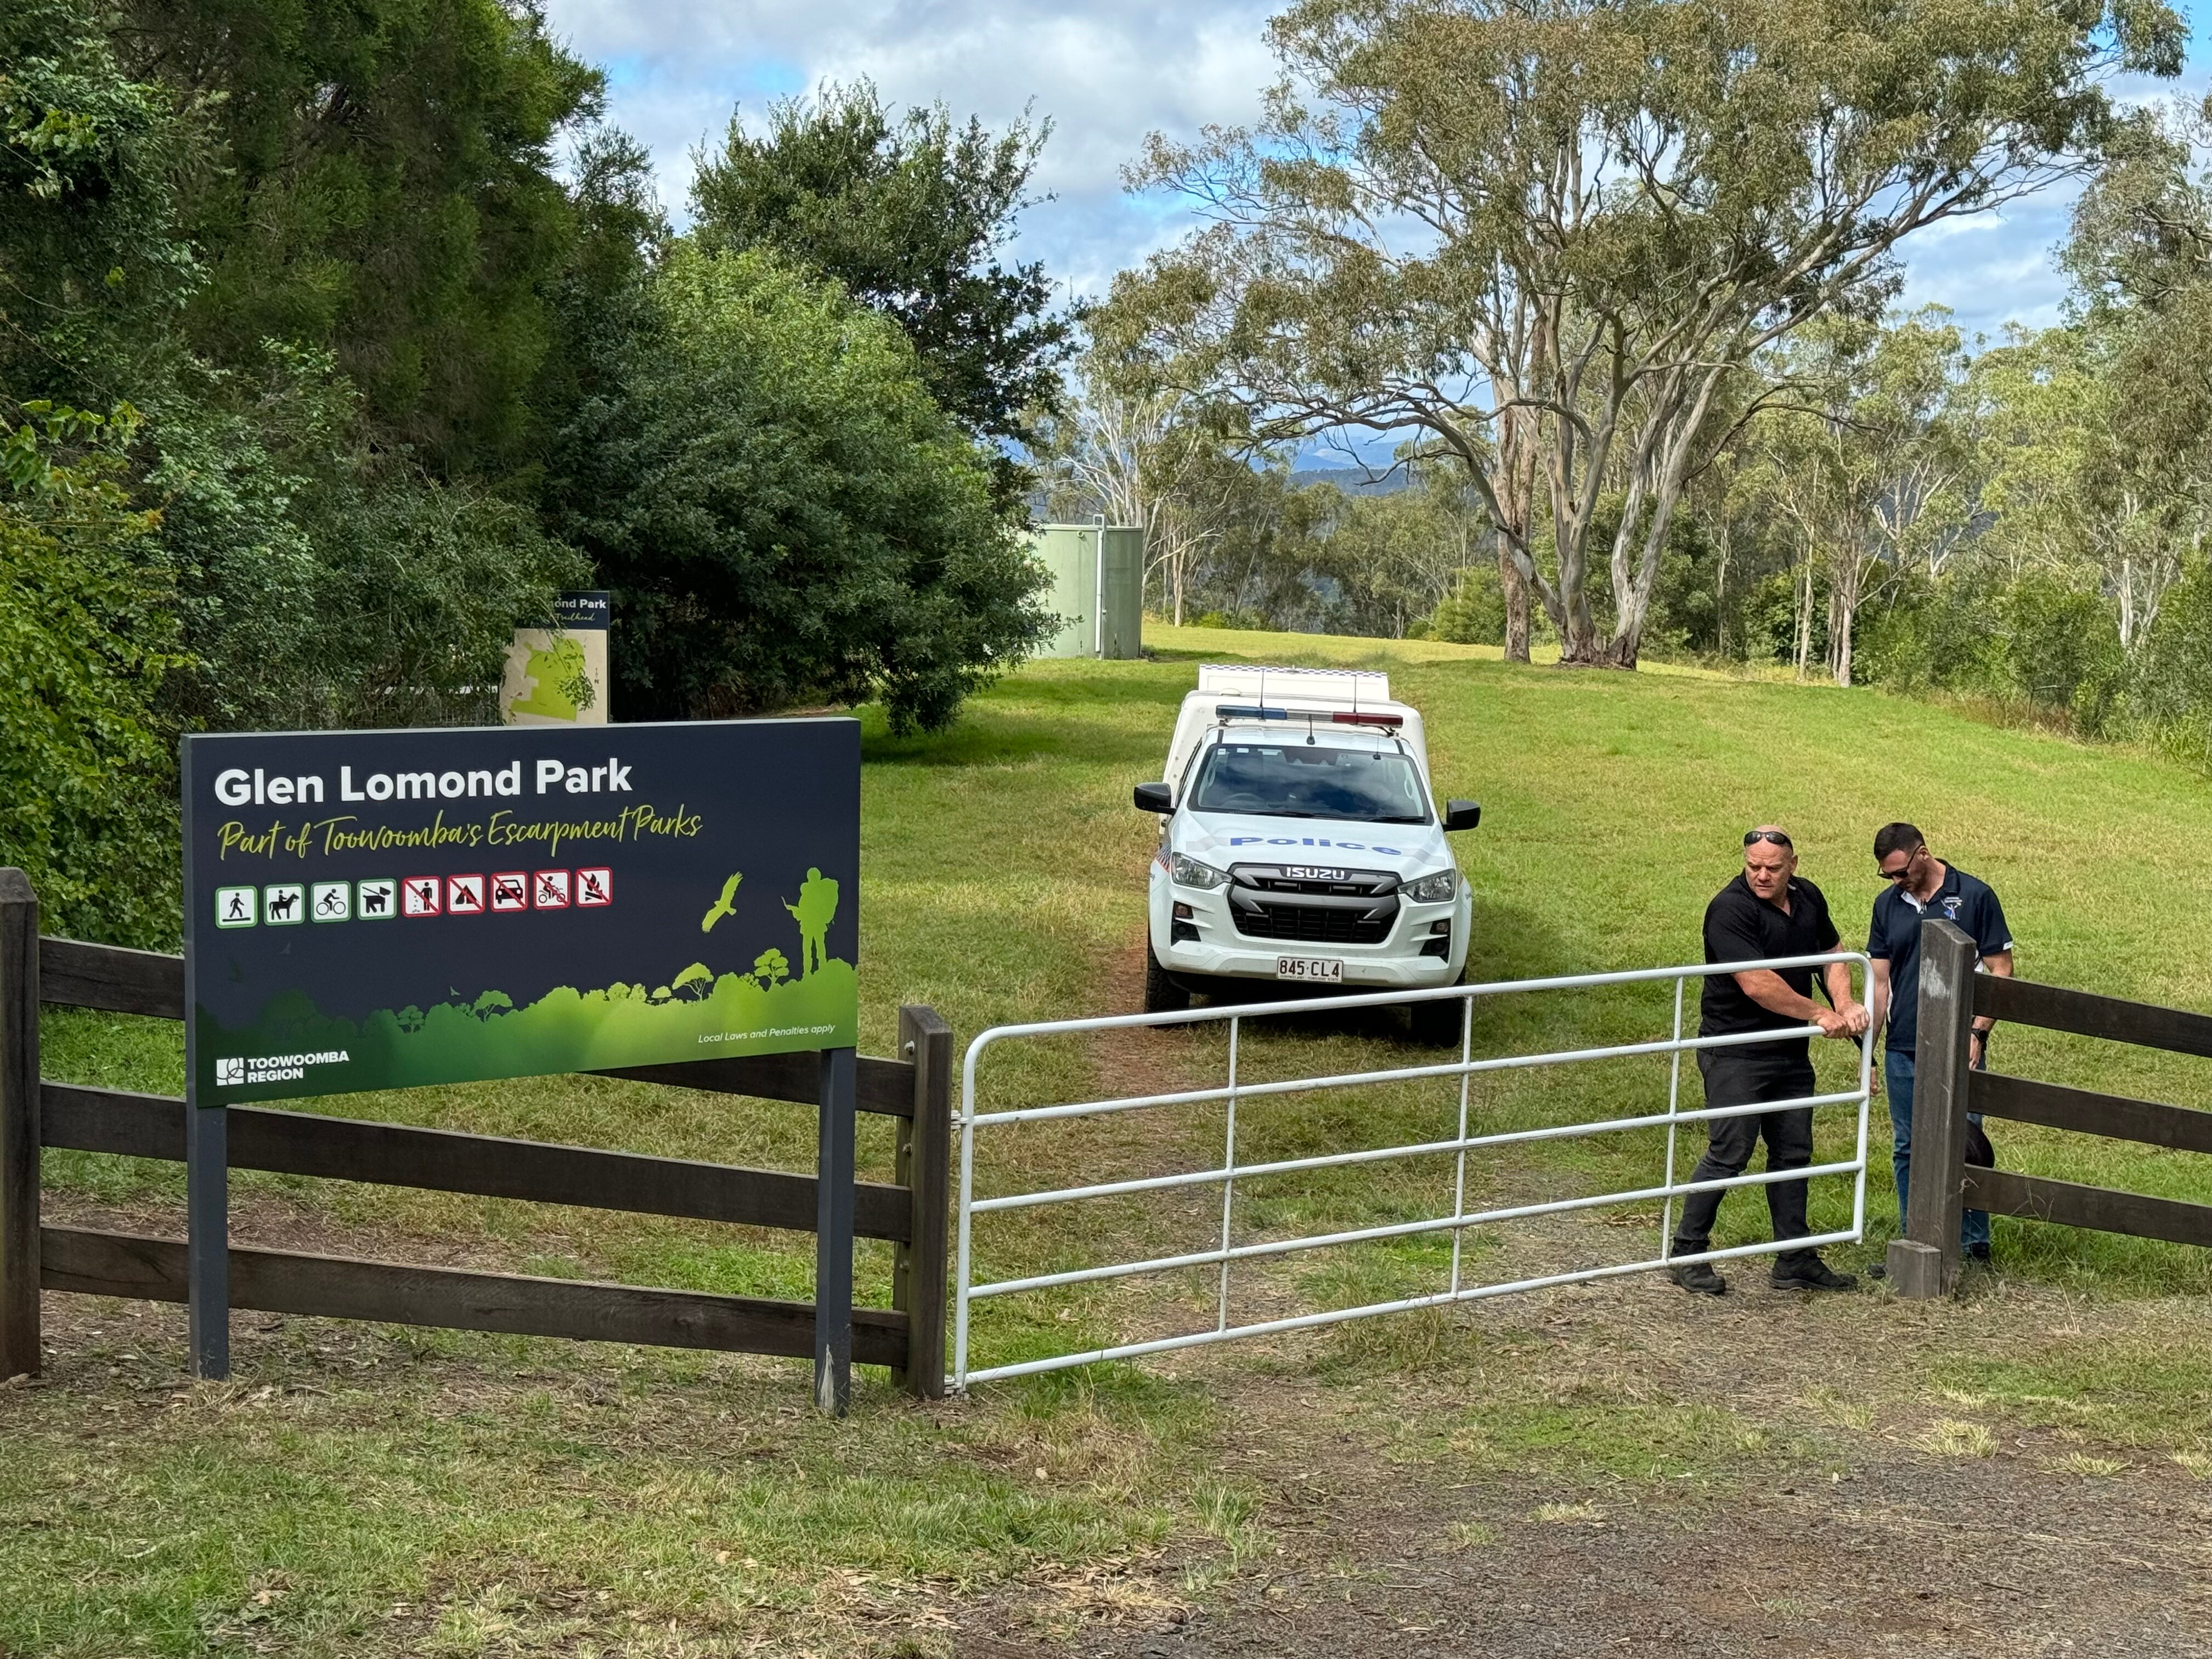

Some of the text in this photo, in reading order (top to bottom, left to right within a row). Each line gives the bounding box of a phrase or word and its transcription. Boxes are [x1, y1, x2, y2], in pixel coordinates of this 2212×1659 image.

[554, 599, 607, 609] ond Park
[215, 758, 633, 806] Glen Lomond Park
[217, 803, 704, 861] Part of Toowoomba's Escarpment Parks
[1230, 837, 1402, 855] Police
[1286, 866, 1345, 881] ISUZU
[698, 1023, 836, 1043] Local Laws and Penalties apply
[247, 1050, 350, 1070] TOOWOOMBA
[247, 1068, 304, 1084] REGION
